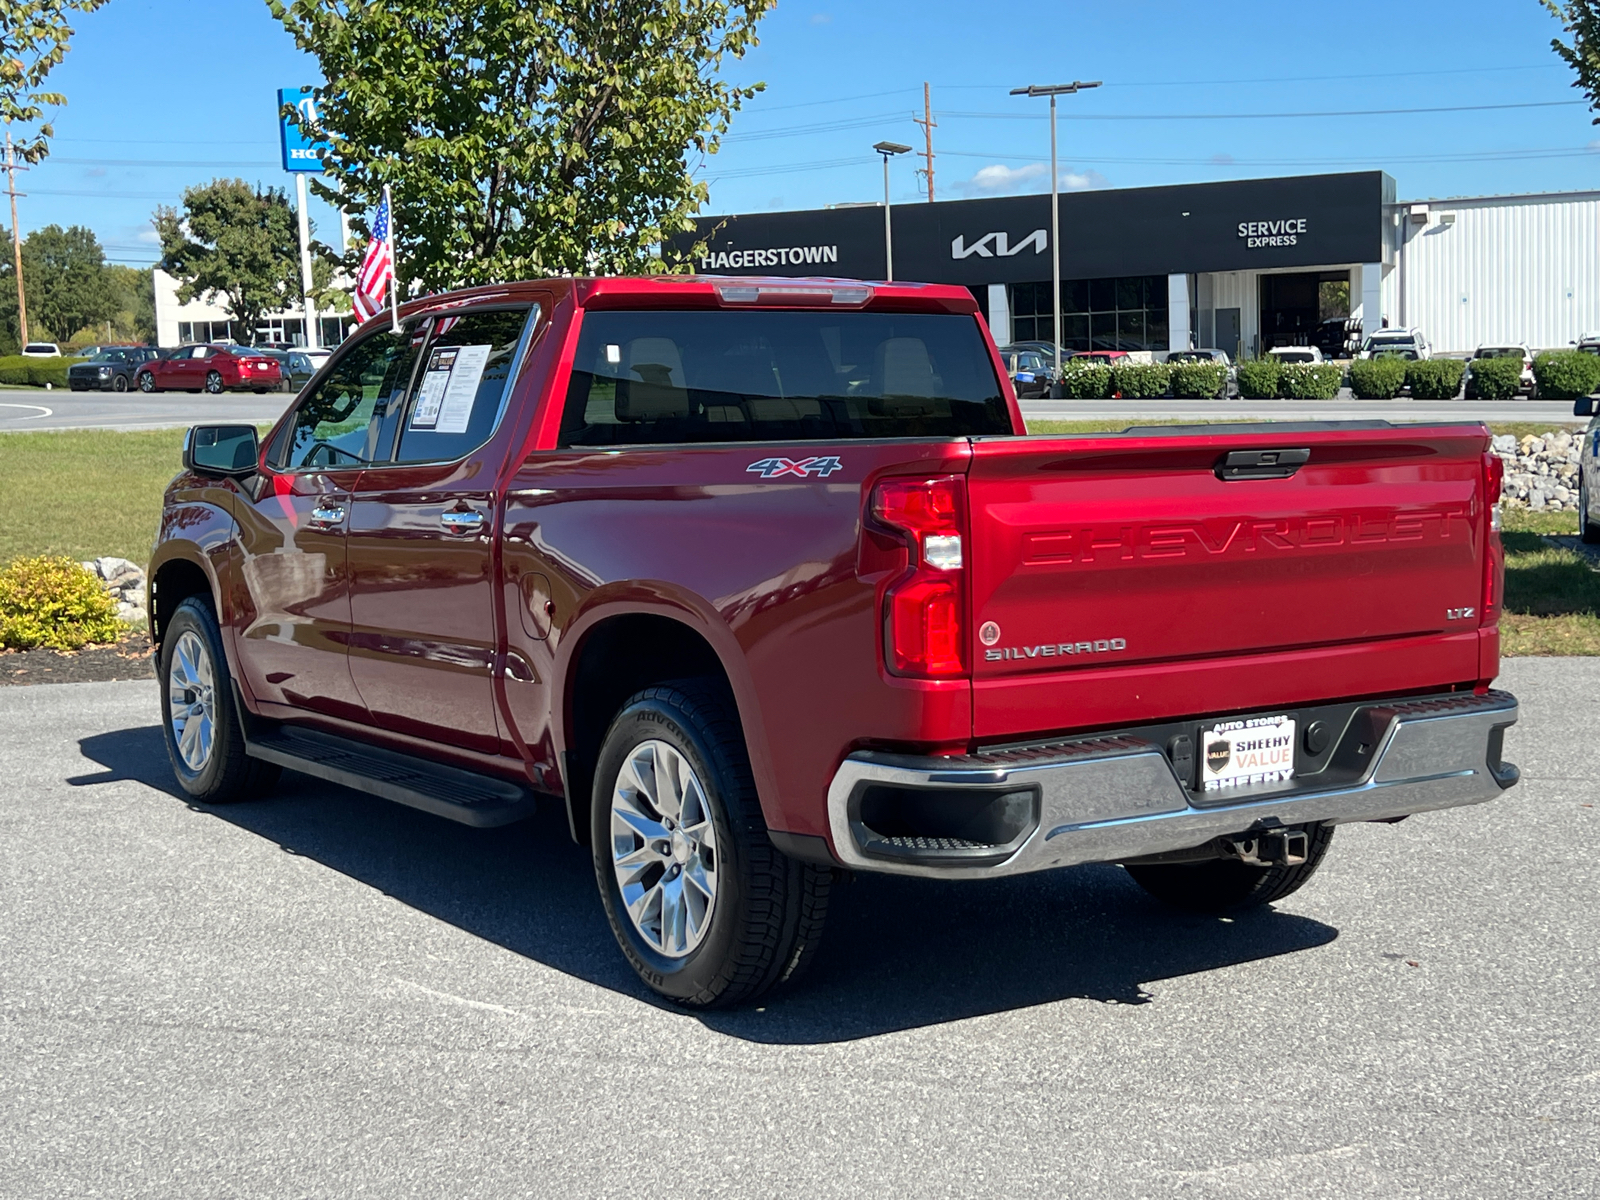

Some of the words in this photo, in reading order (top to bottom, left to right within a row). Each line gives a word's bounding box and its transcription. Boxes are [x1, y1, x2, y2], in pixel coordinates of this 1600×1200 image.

[1238, 218, 1307, 237] SERVICE
[951, 229, 1048, 259] KIA
[1247, 235, 1297, 248] EXPRESS
[701, 245, 838, 269] HAGERSTOWN
[1022, 508, 1463, 566] CHEVROLET
[1446, 607, 1475, 620] LTZ
[985, 637, 1127, 661] SILVERADO
[1213, 721, 1244, 733] AUTO
[1245, 715, 1288, 728] STORES
[1236, 735, 1291, 752] SHEEHY
[1207, 750, 1230, 759] VALUE
[1236, 748, 1290, 768] VALUE
